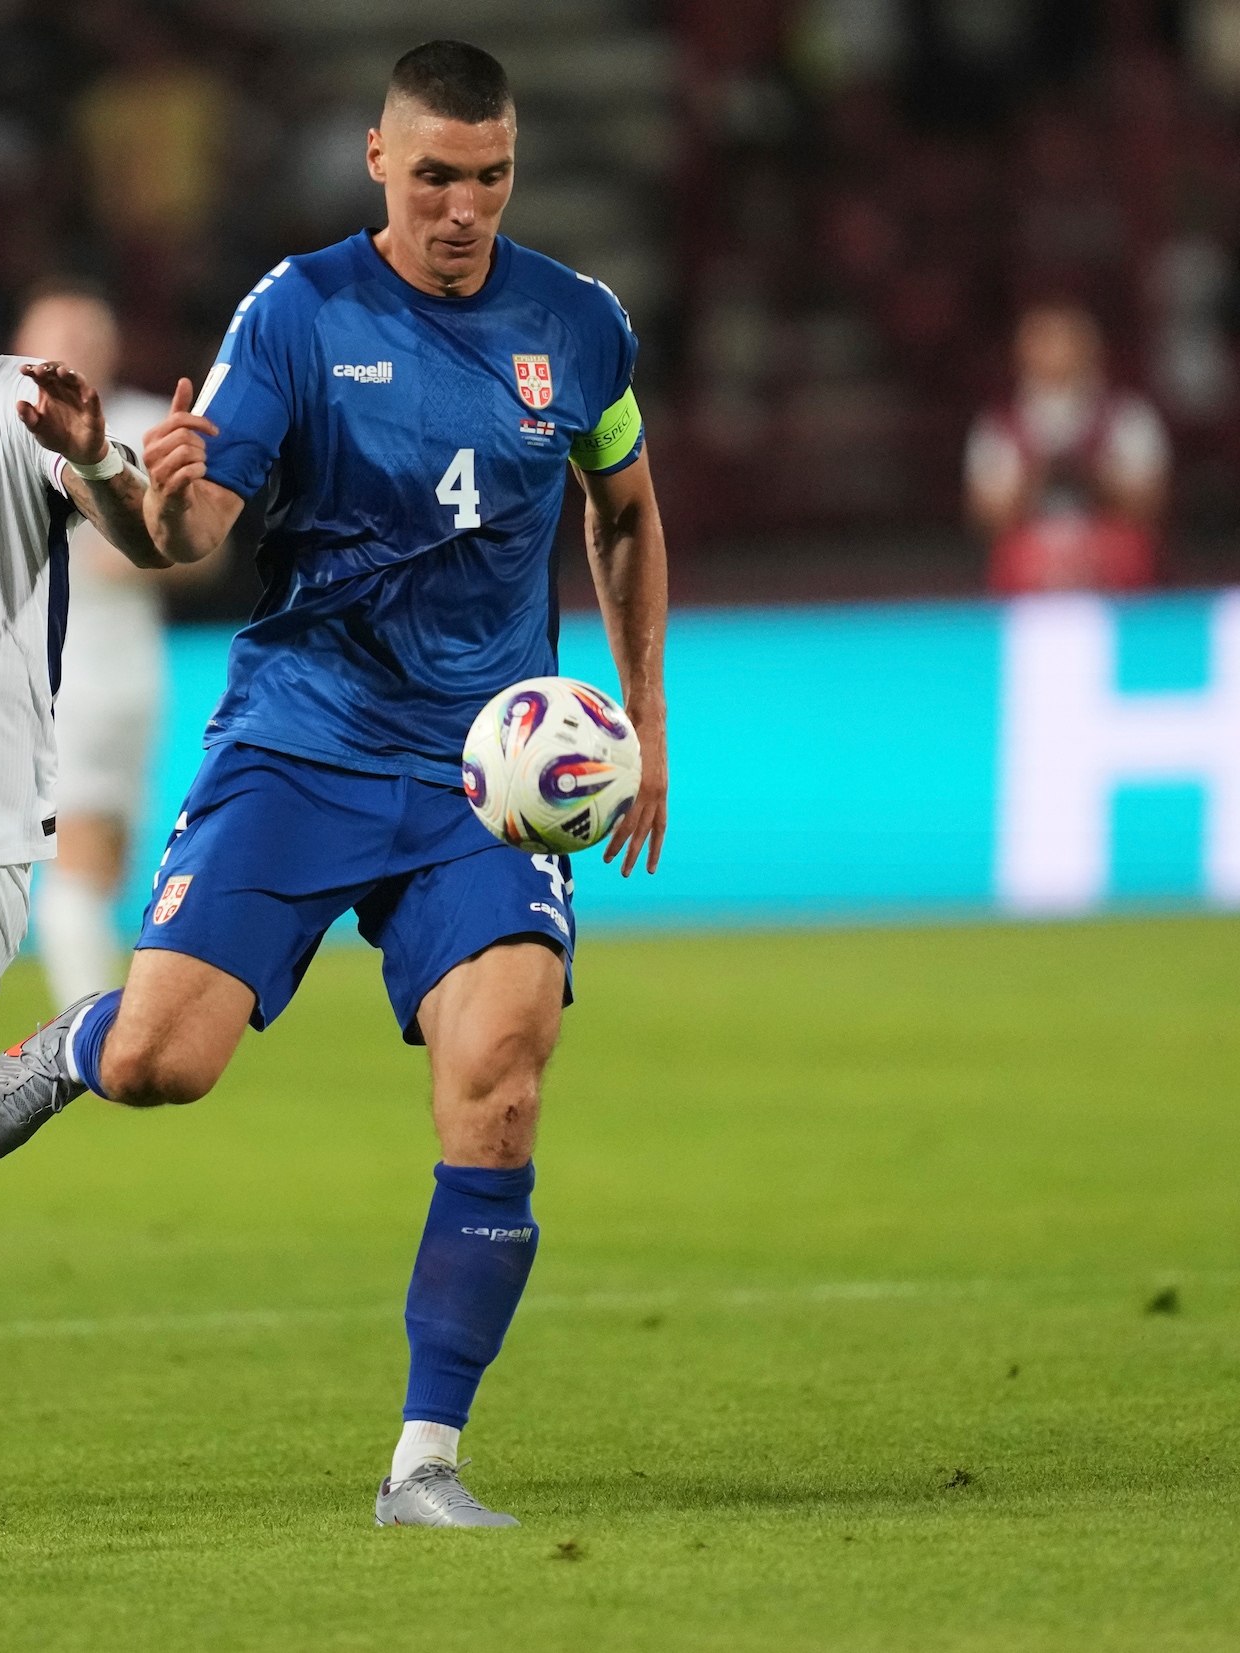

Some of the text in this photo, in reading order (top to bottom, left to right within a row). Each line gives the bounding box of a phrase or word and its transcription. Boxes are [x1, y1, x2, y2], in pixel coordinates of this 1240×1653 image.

[333, 361, 392, 381] capelli
[585, 407, 631, 449] RESPECT
[435, 448, 481, 528] 4
[531, 853, 565, 905] 4
